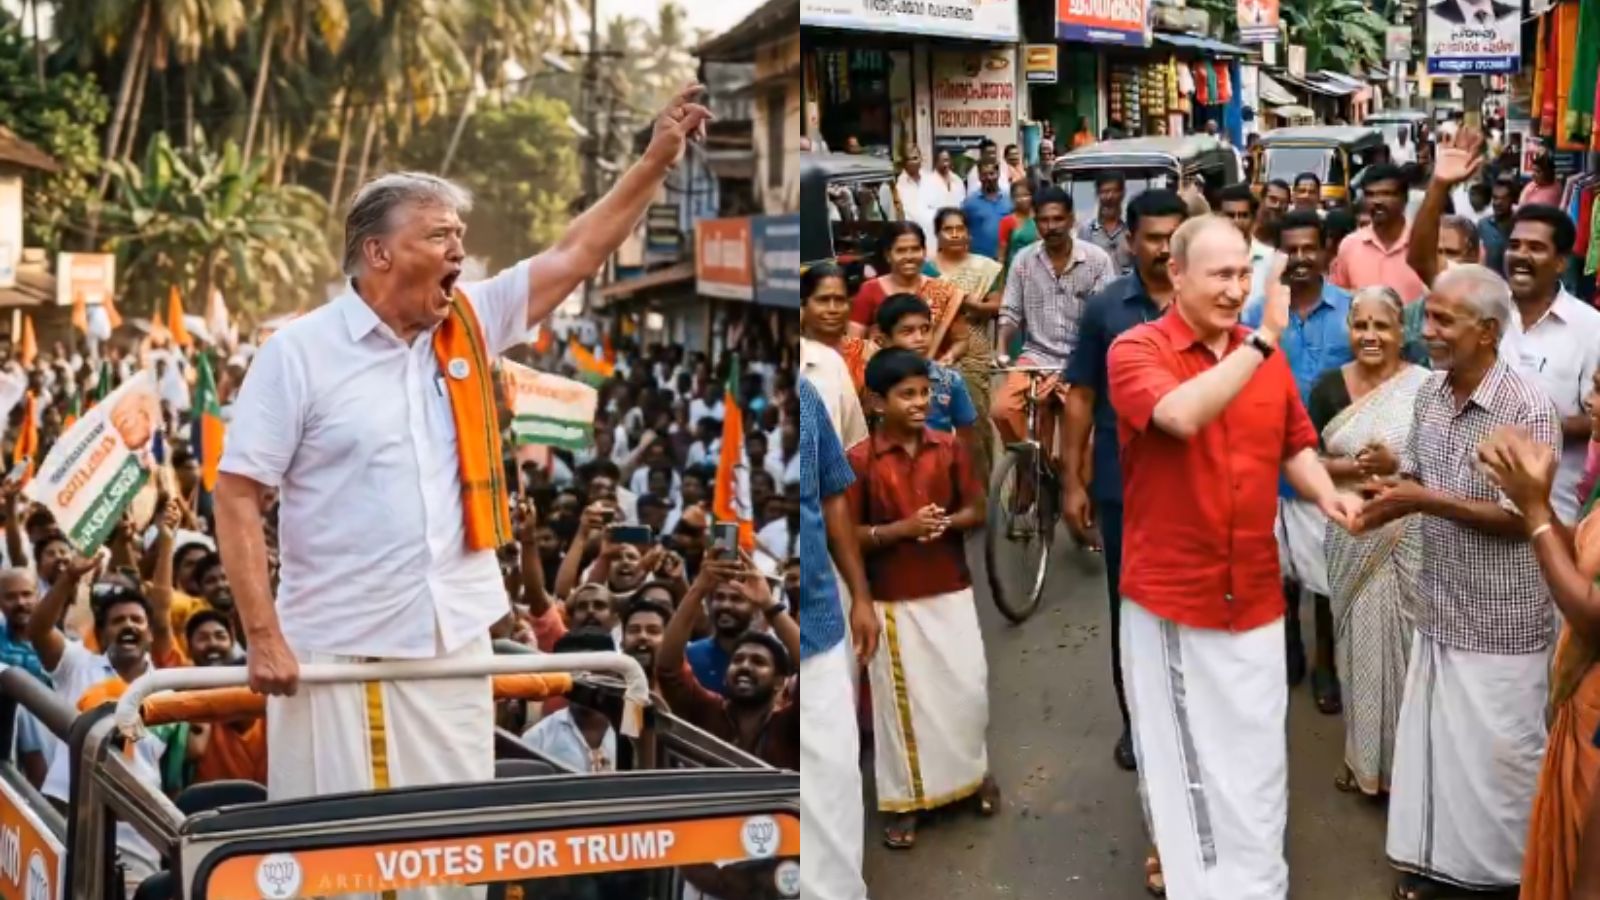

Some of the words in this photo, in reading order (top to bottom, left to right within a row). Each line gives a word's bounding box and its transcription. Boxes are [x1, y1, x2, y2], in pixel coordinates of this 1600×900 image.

[375, 845, 484, 881] VOTES
[494, 839, 558, 871] FOR
[566, 830, 675, 865] TRUMP
